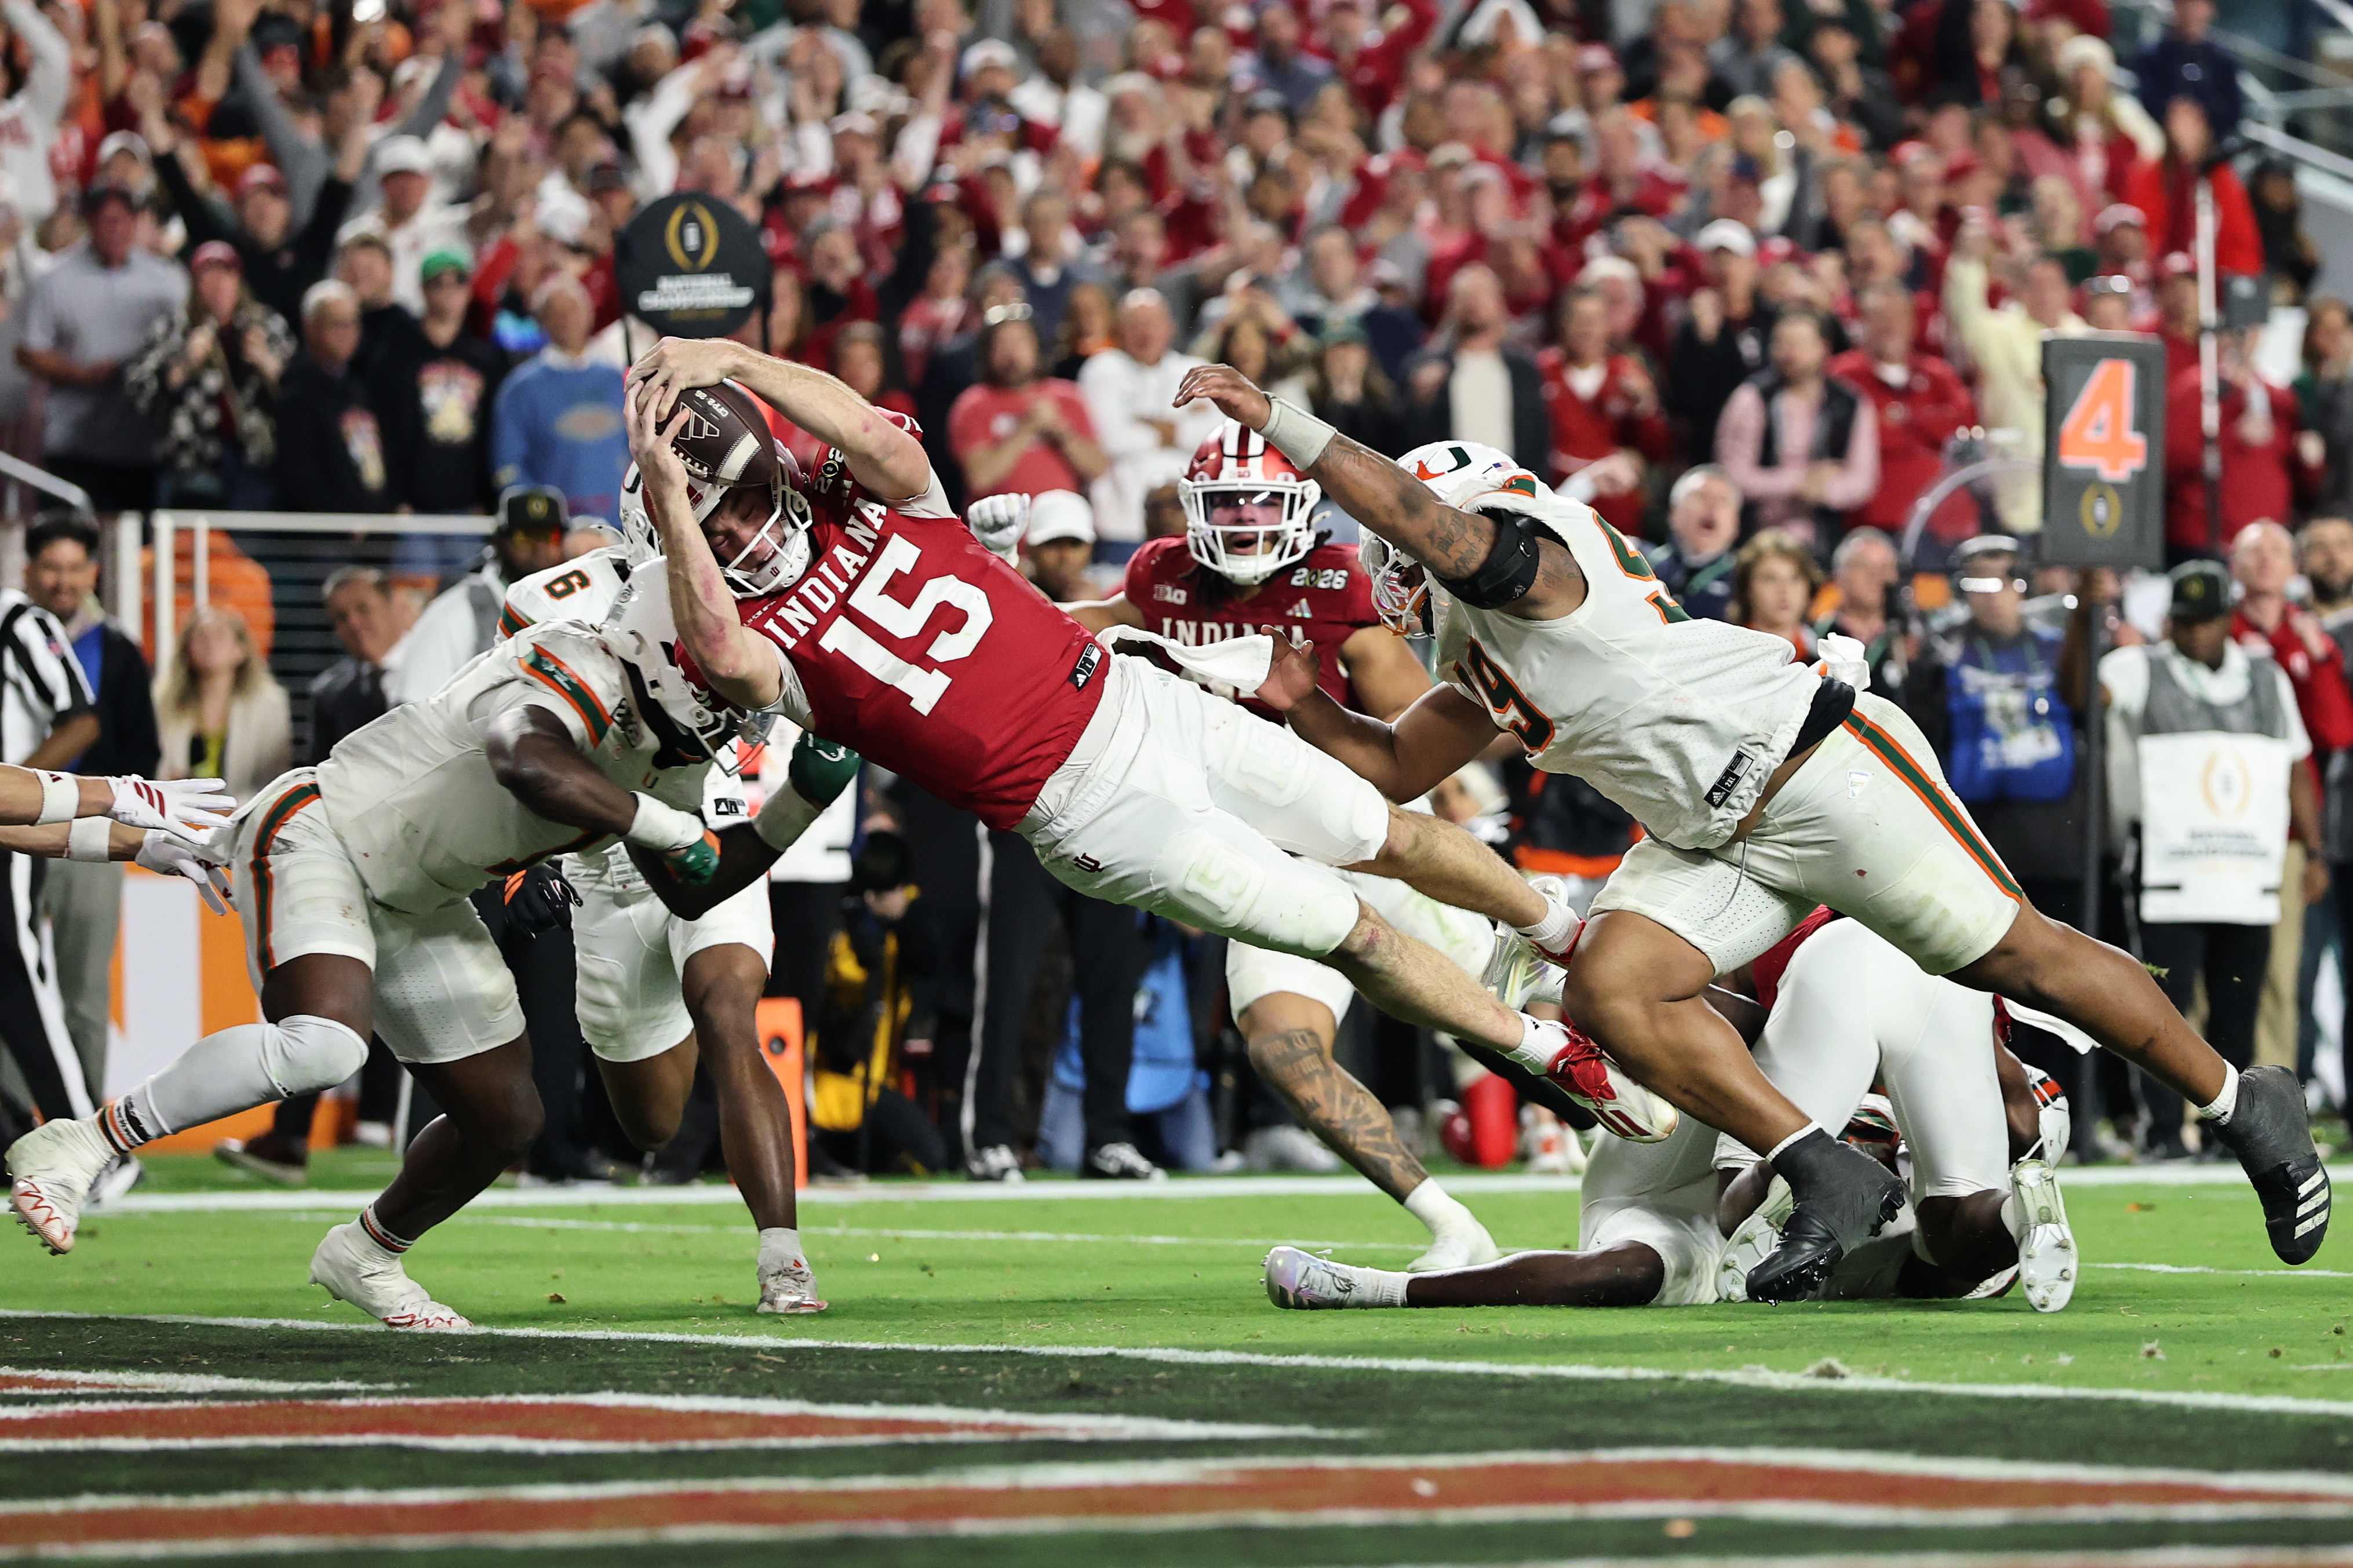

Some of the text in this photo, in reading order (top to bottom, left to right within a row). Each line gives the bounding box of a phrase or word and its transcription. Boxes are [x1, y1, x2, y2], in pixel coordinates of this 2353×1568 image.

[2059, 358, 2147, 483] 4
[543, 569, 591, 600] 6
[763, 497, 887, 649] INDIANA
[818, 533, 994, 716] 15
[1161, 617, 1307, 649] INDIAA
[1725, 777, 1736, 787] 2XL
